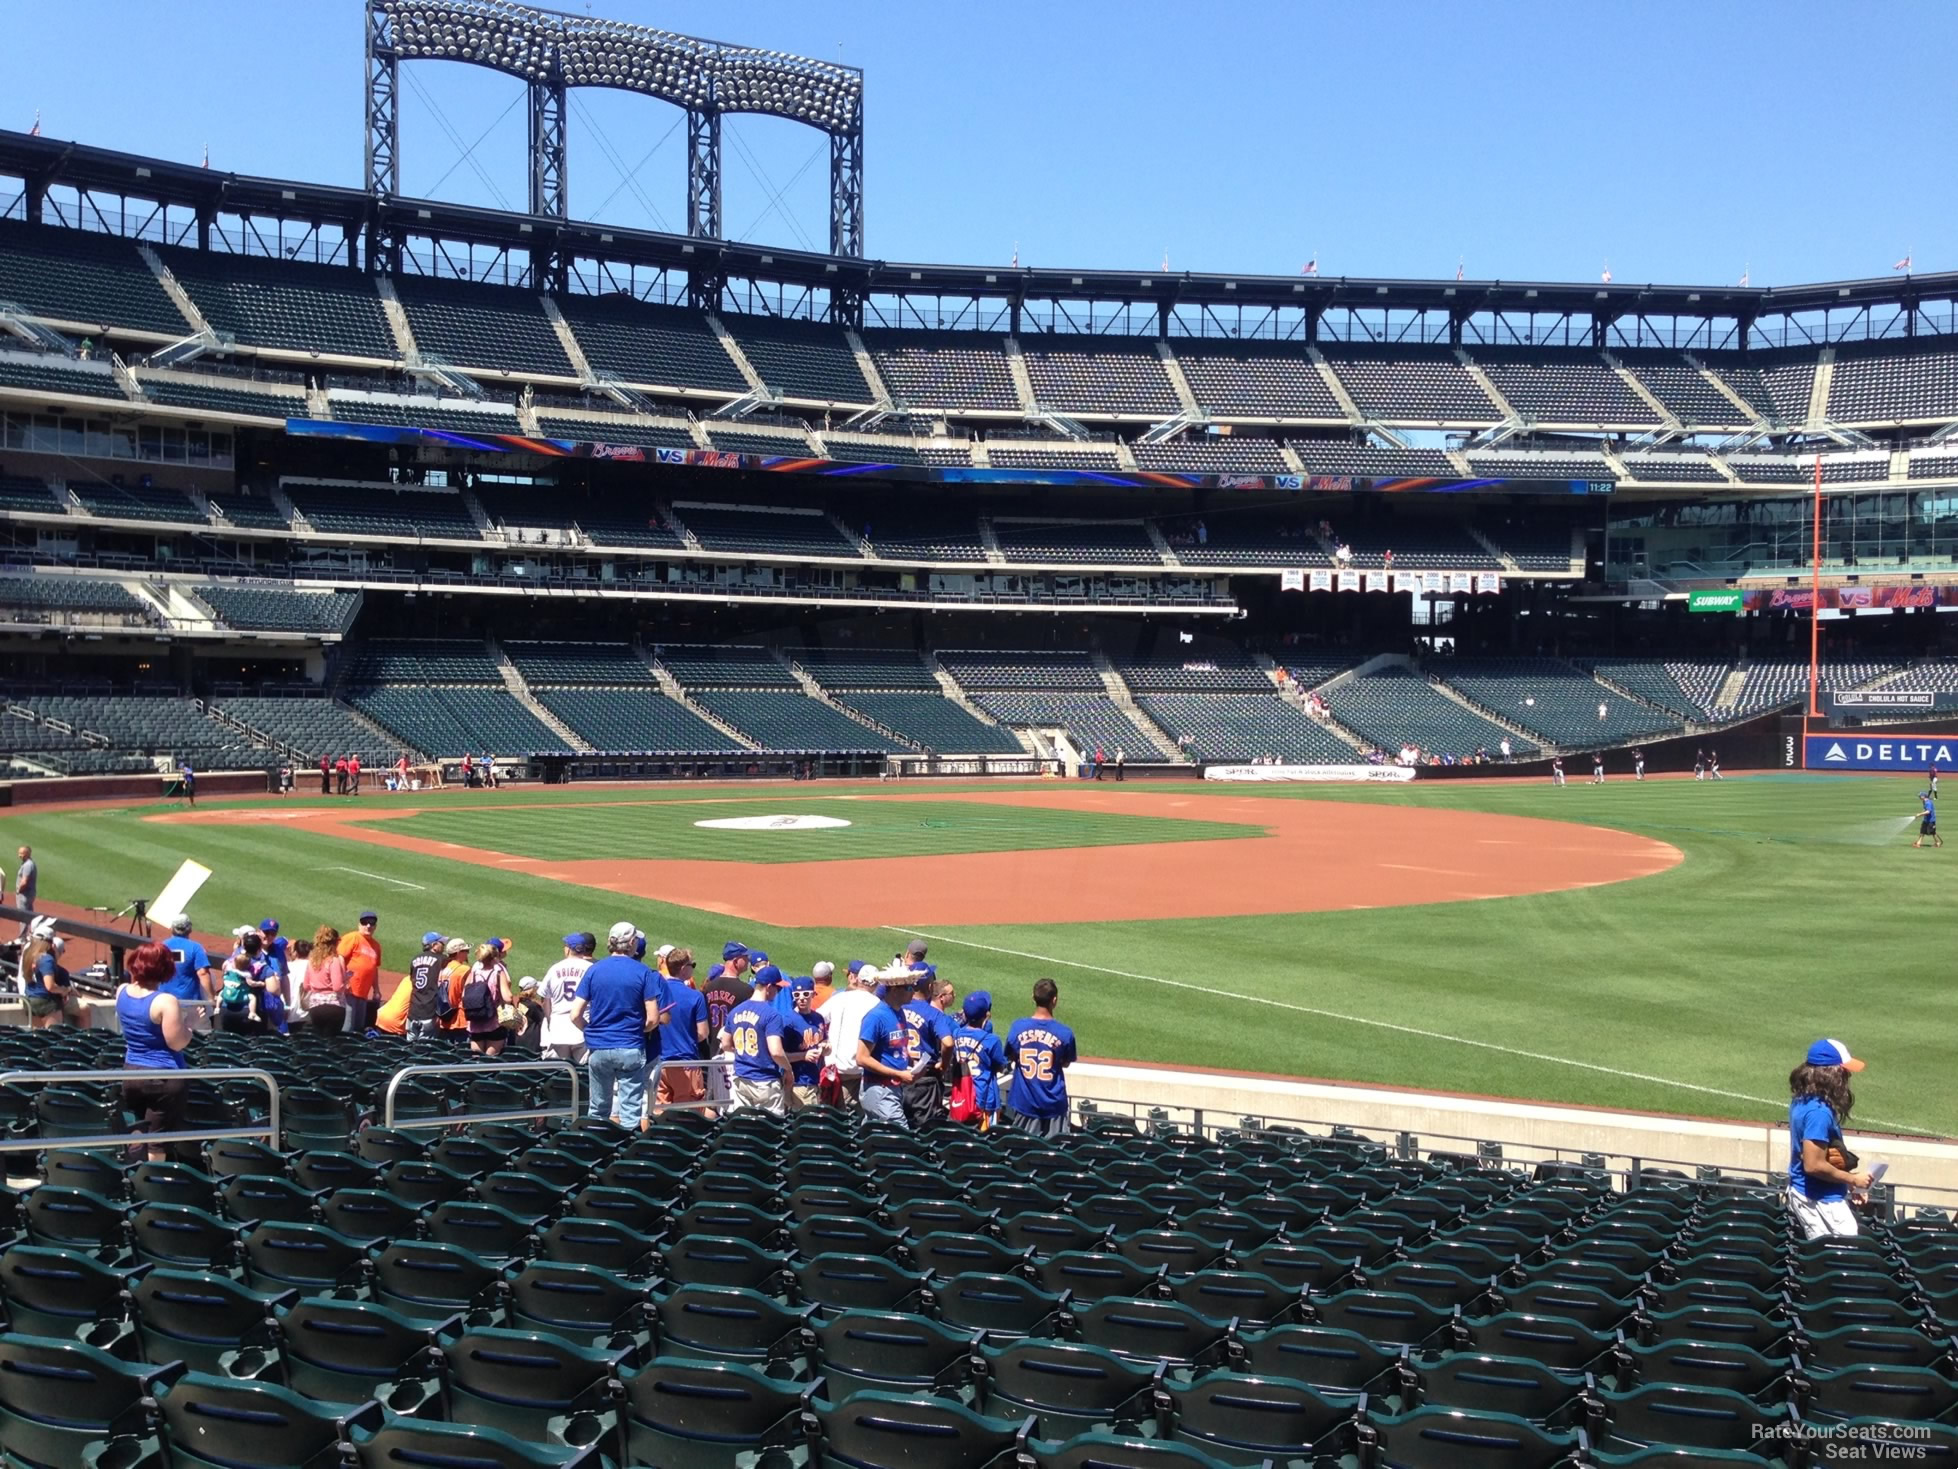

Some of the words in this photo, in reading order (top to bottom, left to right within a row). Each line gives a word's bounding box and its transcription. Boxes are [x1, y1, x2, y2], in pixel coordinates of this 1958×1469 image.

[658, 450, 683, 462] VS
[698, 452, 739, 468] Mets
[1276, 477, 1300, 488] VS
[1590, 483, 1612, 492] 11:22
[1693, 595, 1737, 607] SUBWAY
[1770, 589, 1822, 608] Brave
[1840, 593, 1870, 606] VS
[1885, 586, 1934, 608] Mets
[1868, 695, 1895, 703] CHOLULA
[1896, 695, 1908, 703] HOT
[1910, 695, 1930, 703] SAUCE
[1785, 736, 1794, 767] 335
[1856, 744, 1952, 762] DELTA
[415, 968, 429, 989] 5
[562, 981, 577, 1002] 5
[733, 1027, 759, 1057] 48
[907, 1028, 920, 1059] 2
[1018, 1029, 1062, 1048] CESPEDES
[1019, 1048, 1054, 1081] 52
